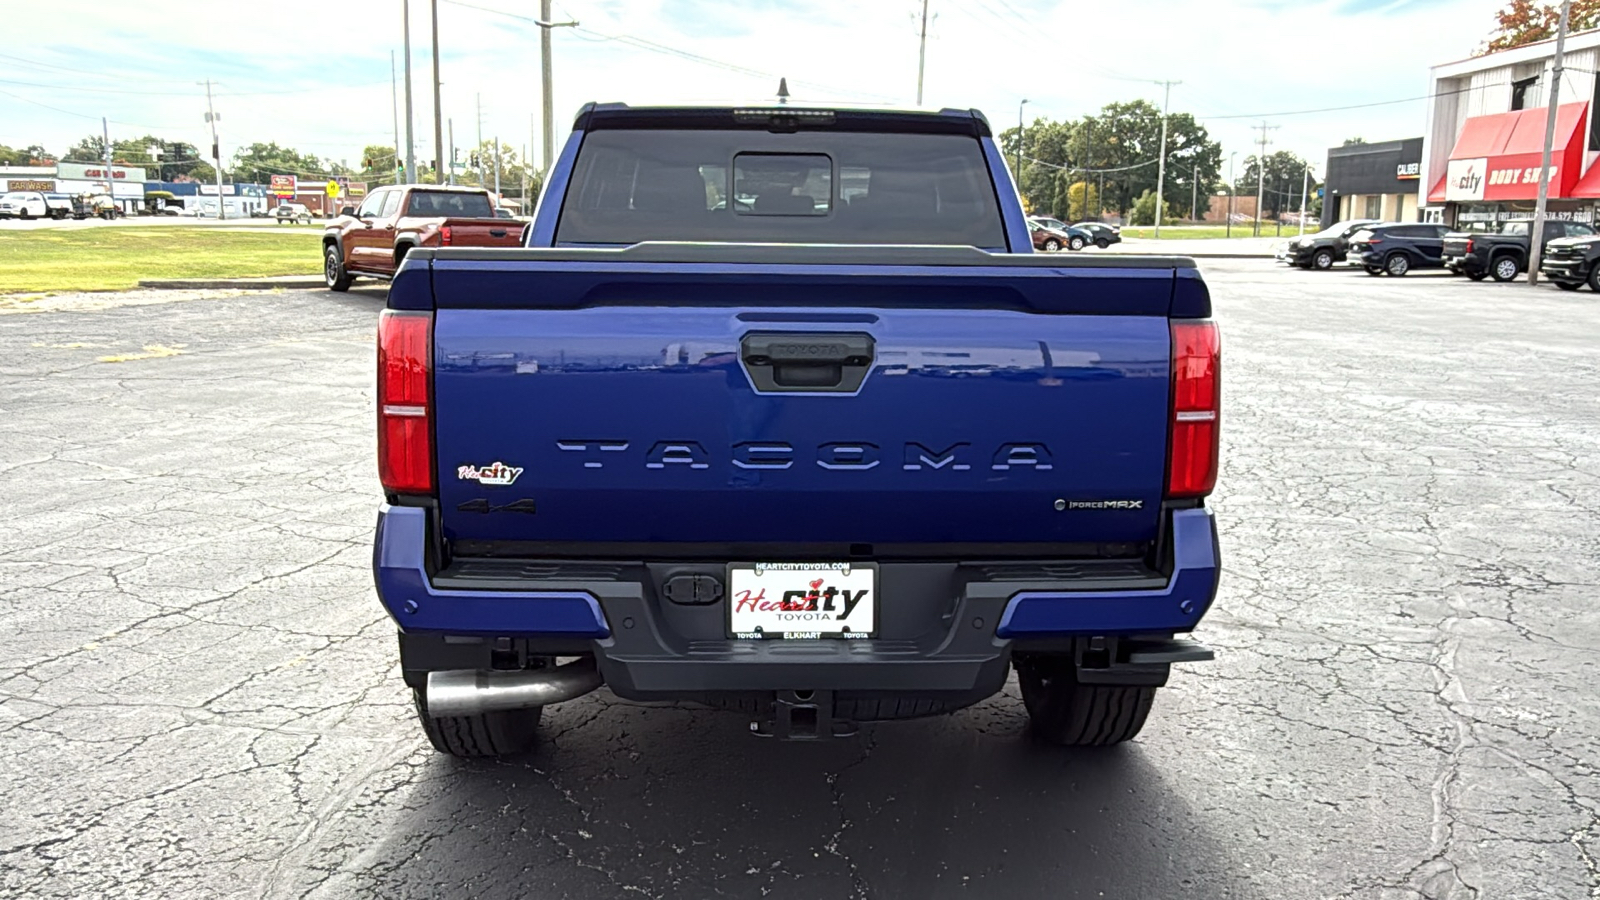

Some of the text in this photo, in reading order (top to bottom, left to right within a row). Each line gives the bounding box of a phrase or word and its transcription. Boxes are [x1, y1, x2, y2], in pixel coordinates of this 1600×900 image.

[84, 169, 101, 177] CAR
[1488, 166, 1558, 185] BODY SHP
[10, 181, 53, 190] CAR WASH
[1459, 168, 1481, 194] city
[777, 345, 840, 354] TOYOTA
[557, 440, 1053, 469] TACOMA
[480, 463, 523, 483] city
[756, 562, 850, 570] HEARTCITYTOYOTA.COM
[735, 579, 869, 620] Heart city
[776, 613, 831, 621] TOYOTA
